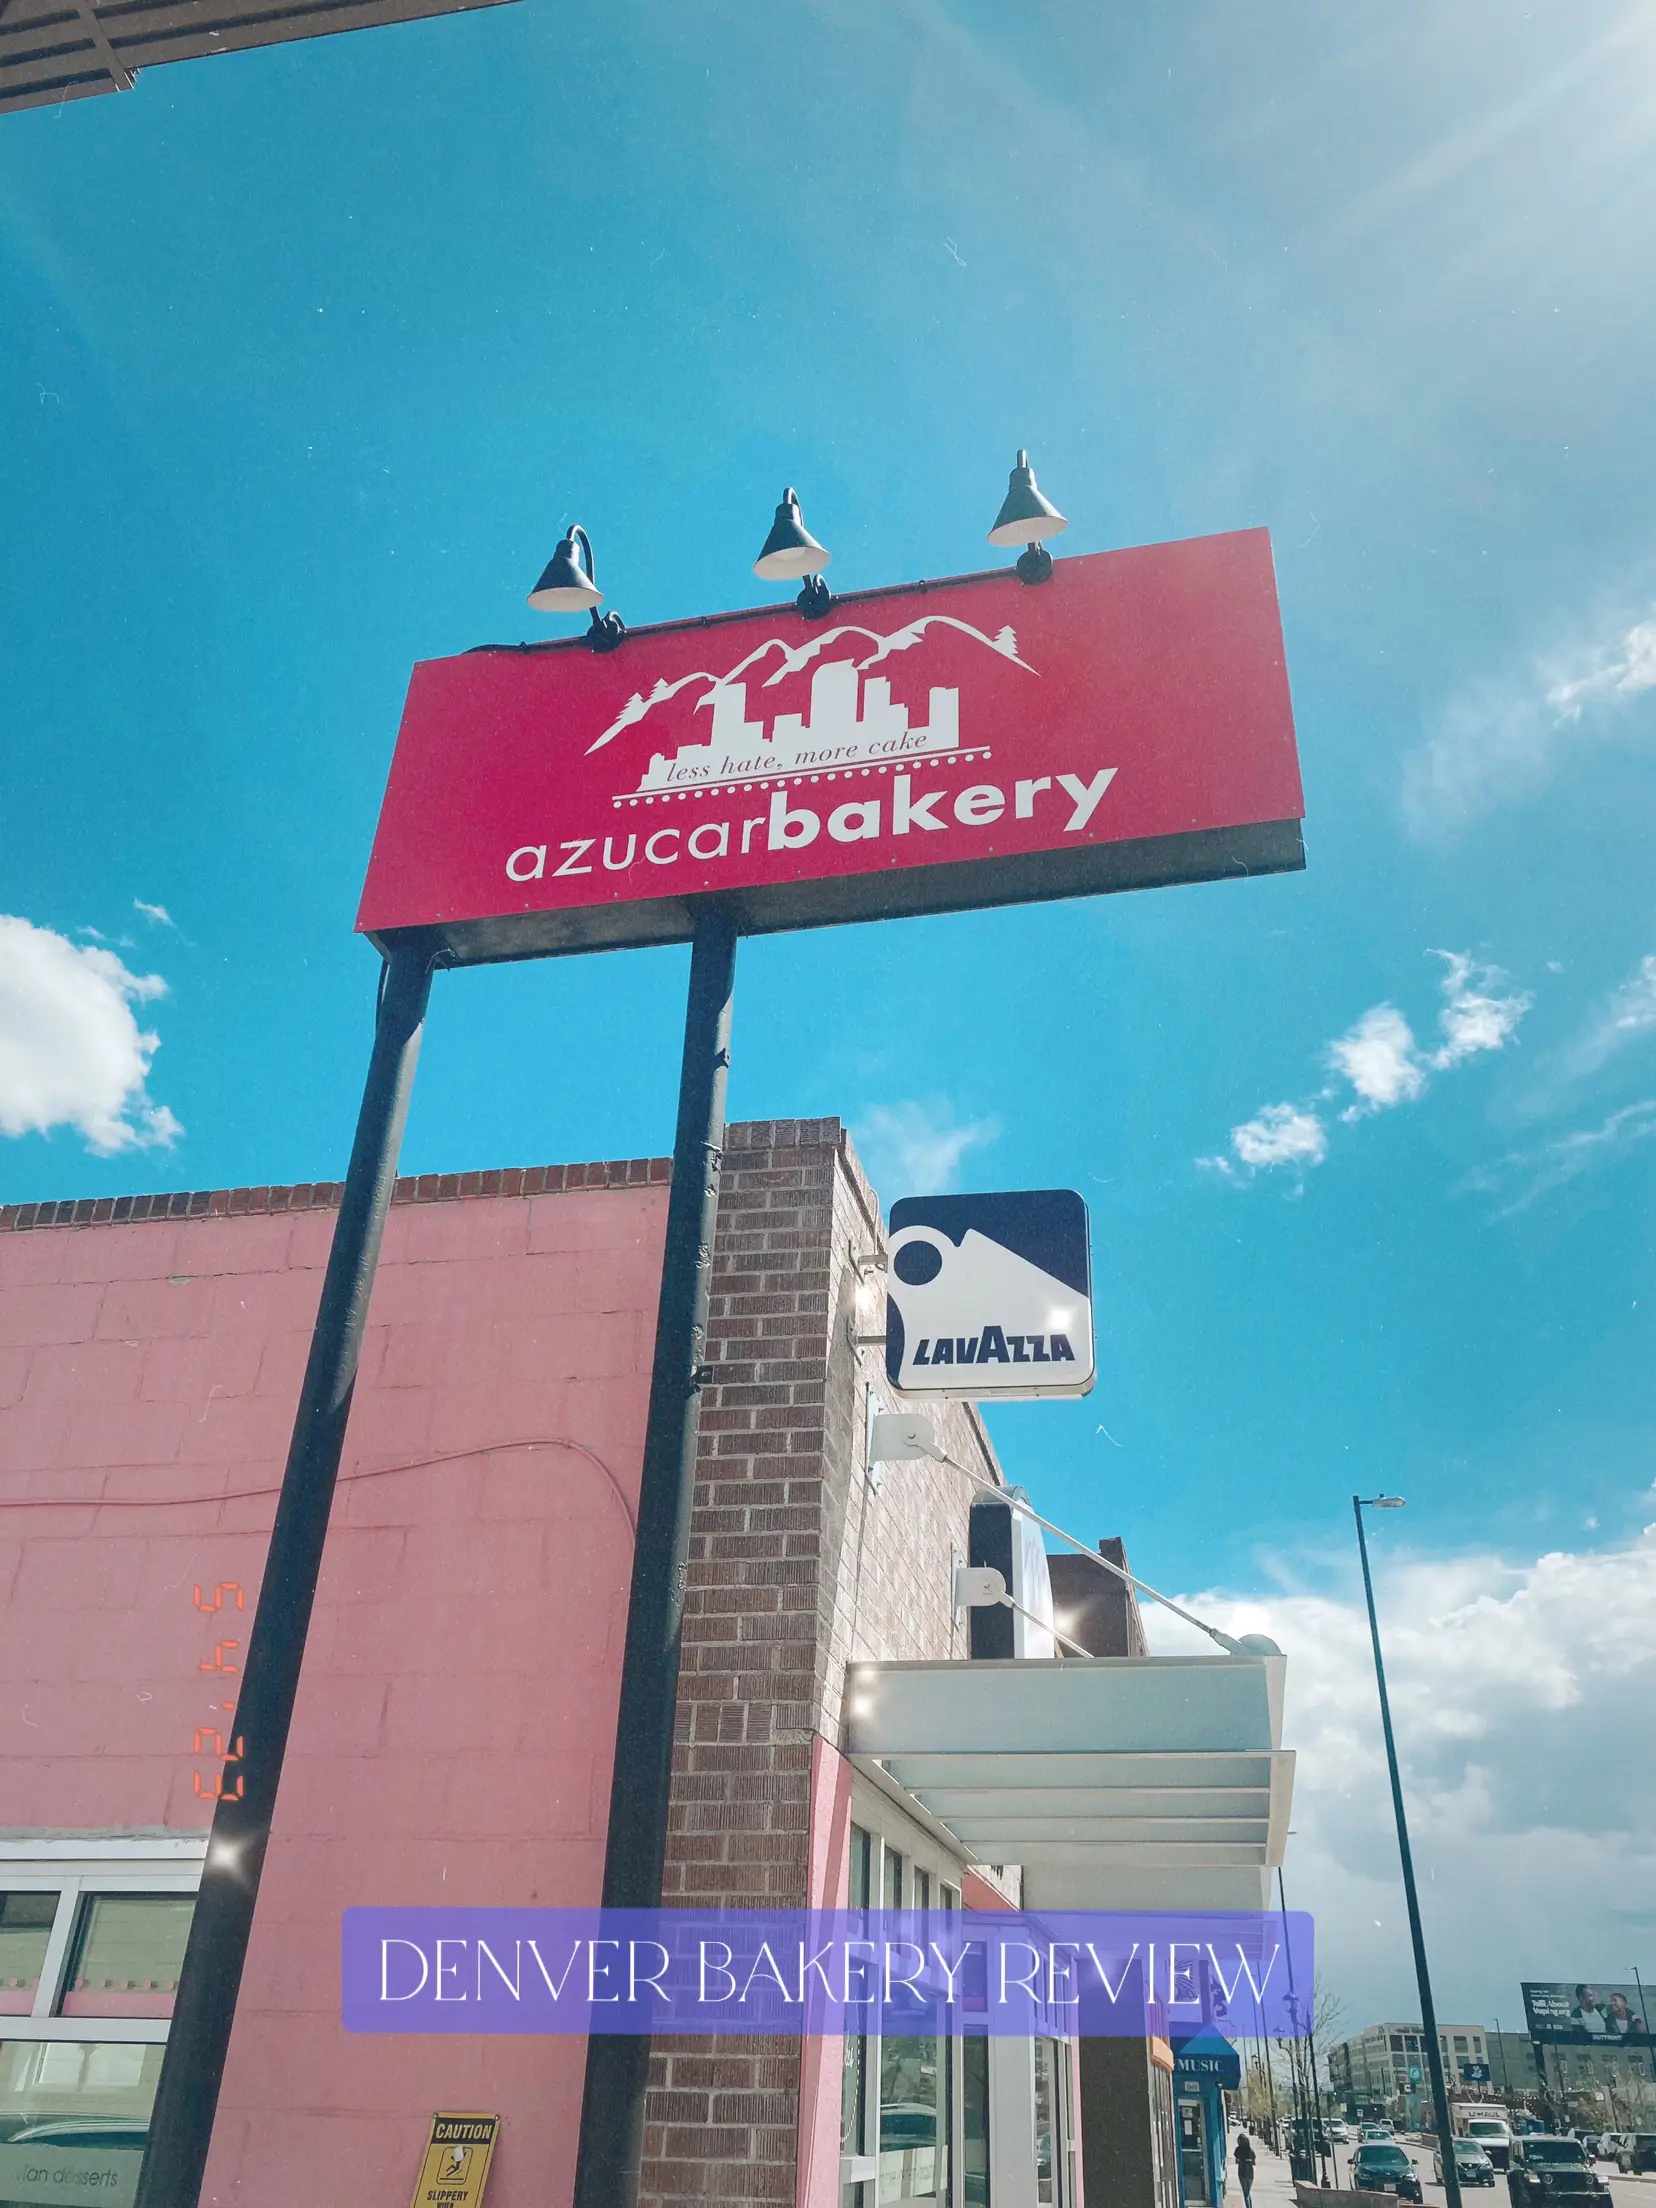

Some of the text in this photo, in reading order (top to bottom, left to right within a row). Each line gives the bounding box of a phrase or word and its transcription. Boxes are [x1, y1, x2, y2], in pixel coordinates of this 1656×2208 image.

[666, 731, 927, 782] less hate, more cake
[912, 1325, 1076, 1366] LAVAZZA
[1178, 2059, 1224, 2072] MUSIC
[435, 2123, 493, 2139] CAUTION
[427, 2190, 469, 2202] SLIPPERY
